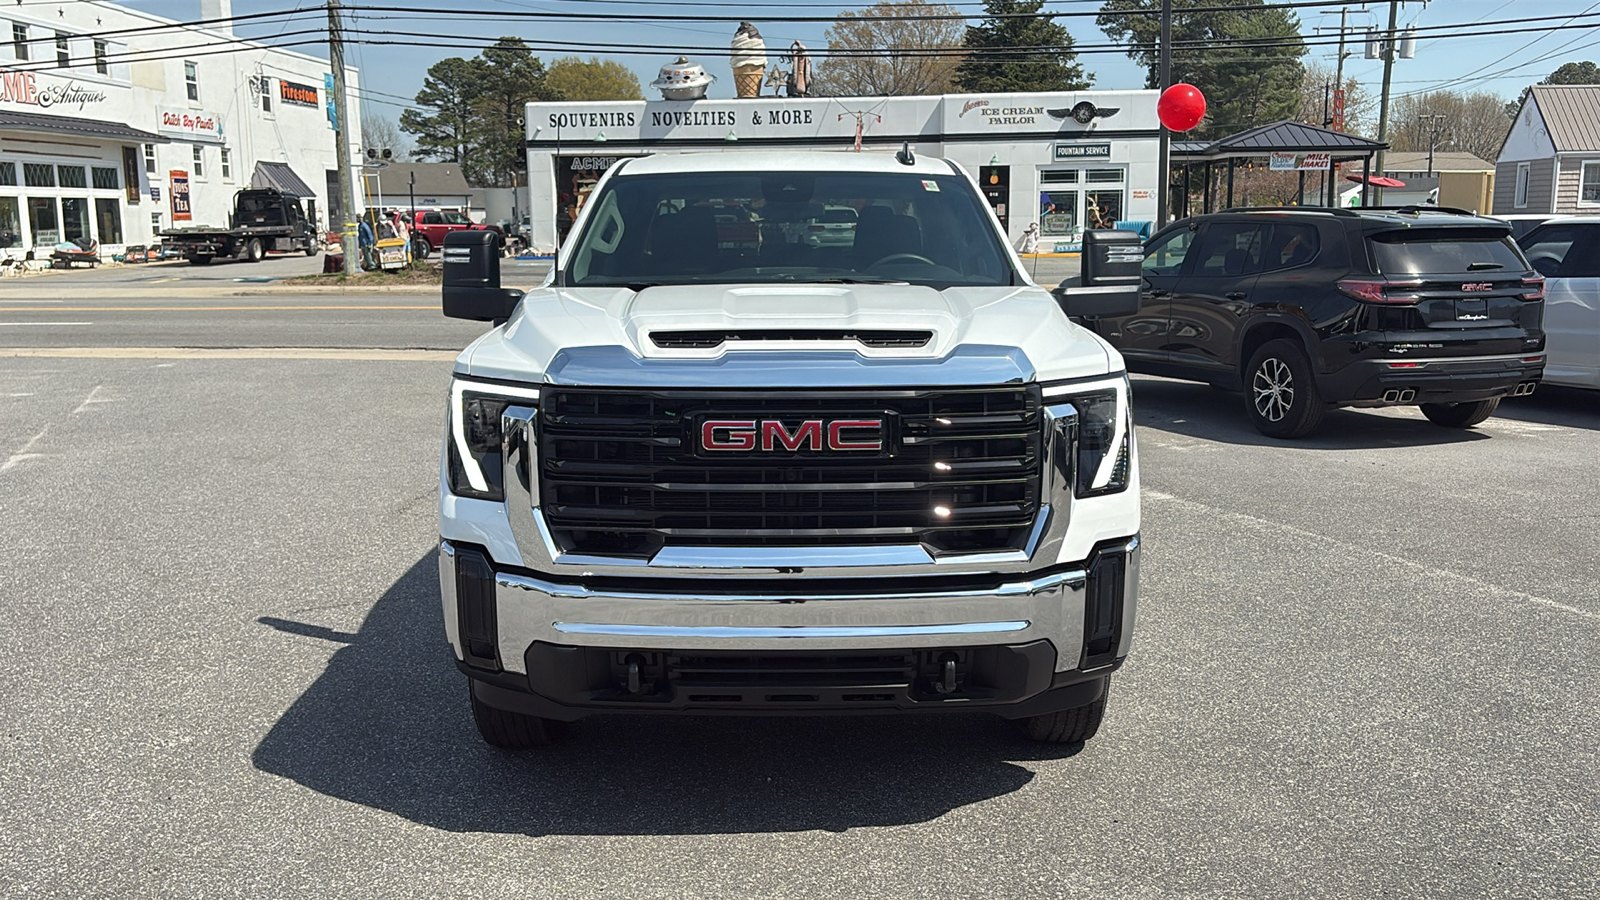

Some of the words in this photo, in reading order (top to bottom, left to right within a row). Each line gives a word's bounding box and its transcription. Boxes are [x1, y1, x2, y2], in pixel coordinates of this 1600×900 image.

[0, 68, 39, 105] ME
[280, 81, 318, 104] Firestone
[981, 107, 1000, 116] ICE
[1002, 106, 1044, 116] CREAM
[163, 112, 180, 126] Dutch
[183, 114, 195, 131] Boy
[195, 116, 214, 130] Paints
[549, 112, 635, 128] SOUVENIRS
[652, 111, 736, 127] NOVELTIES
[752, 111, 763, 125] &
[769, 110, 813, 125] MORE
[988, 116, 1035, 125] PARLOR
[1057, 146, 1085, 156] FOUNTAIN
[1085, 146, 1108, 155] SERVICE
[1300, 160, 1329, 168] SHAKES
[1461, 283, 1493, 292] GMC
[701, 419, 882, 451] GMC
